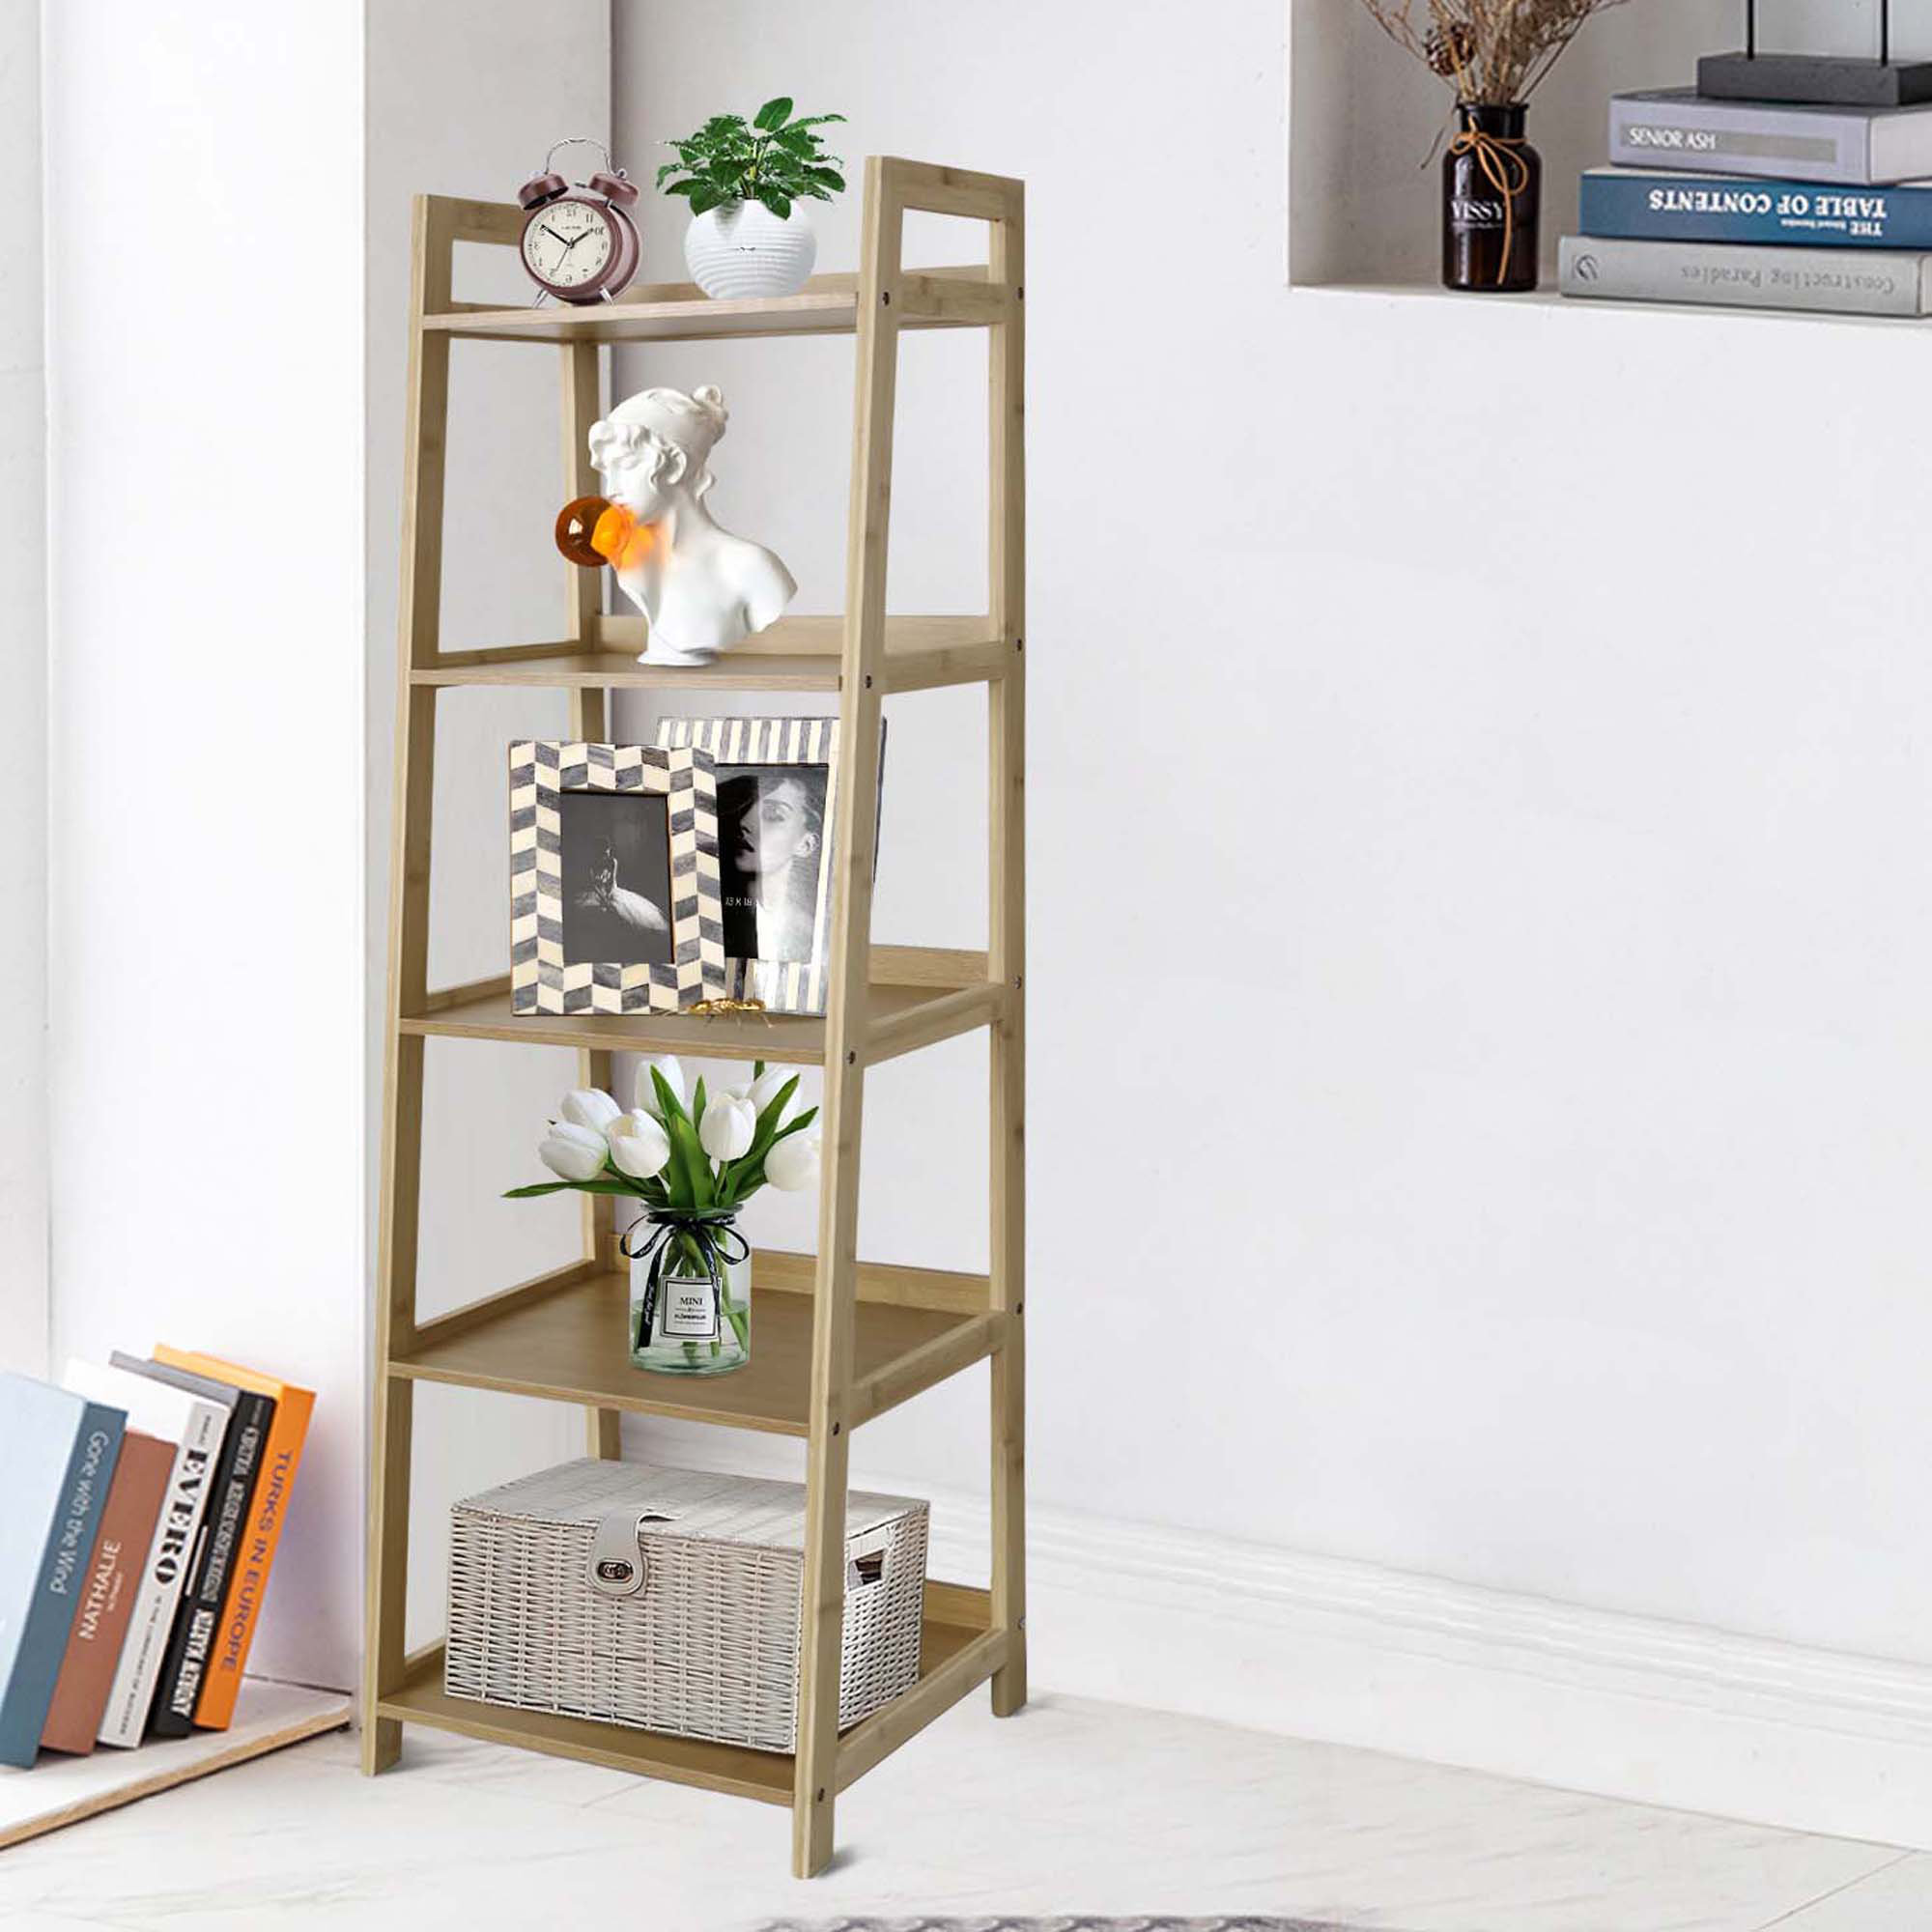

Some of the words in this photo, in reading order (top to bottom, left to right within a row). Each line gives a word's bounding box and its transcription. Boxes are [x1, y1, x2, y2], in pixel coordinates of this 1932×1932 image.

[1629, 127, 1683, 148] SENIOR
[1687, 132, 1717, 150] ASH
[1649, 189, 1772, 213] CONTENTS
[1776, 194, 1808, 214] OF
[1815, 196, 1887, 218] TABLE
[1850, 221, 1883, 237] THE
[1771, 269, 1895, 294] Constructing
[82, 1430, 109, 1476] Gone
[71, 1479, 94, 1516] with
[259, 1450, 294, 1532] TURKS
[155, 1450, 208, 1584] EVERO
[62, 1519, 85, 1548] the
[248, 1537, 267, 1562] IN
[50, 1549, 78, 1594] Wind
[78, 1540, 122, 1640] NATHALIE
[222, 1569, 261, 1672] EUROPE
